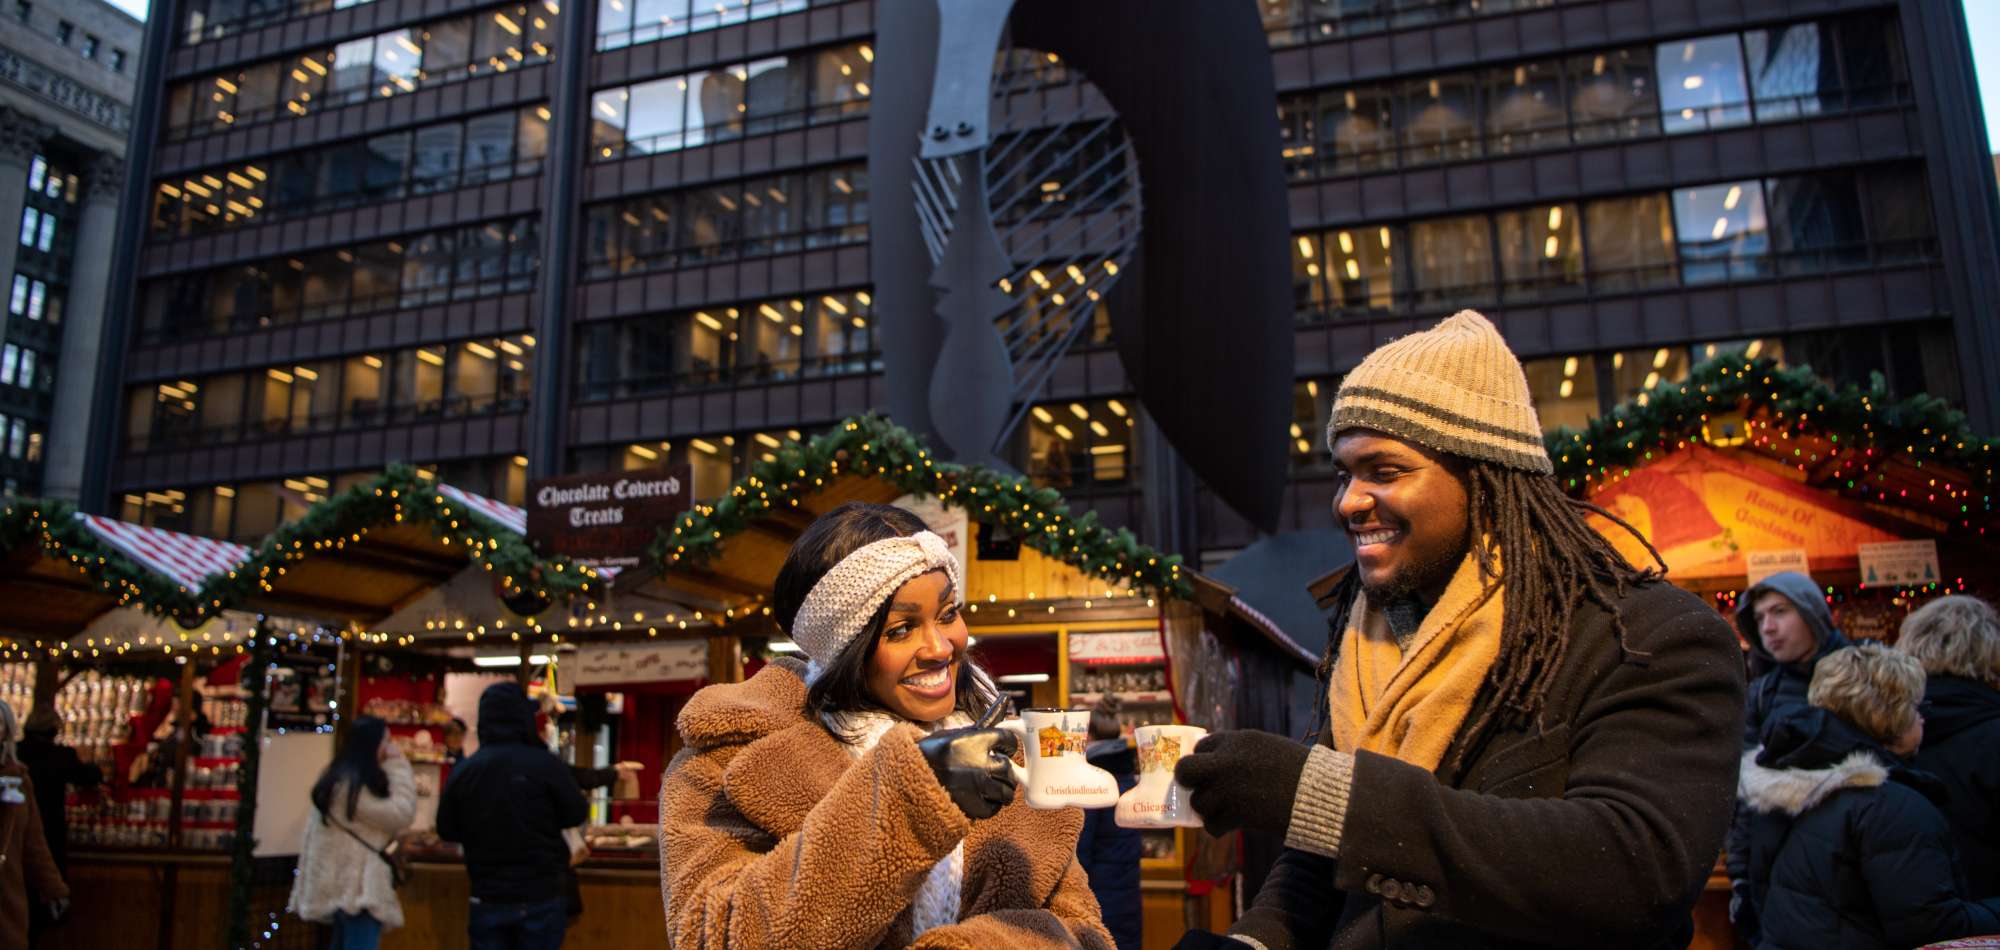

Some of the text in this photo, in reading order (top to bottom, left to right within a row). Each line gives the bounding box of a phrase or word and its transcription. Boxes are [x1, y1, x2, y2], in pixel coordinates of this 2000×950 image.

[537, 476, 680, 507] Chocolate Covered
[570, 506, 624, 527] Treats
[1745, 490, 1816, 527] Home Of
[1045, 785, 1109, 796] Christkindlmarket
[1133, 802, 1173, 814] Chicago
